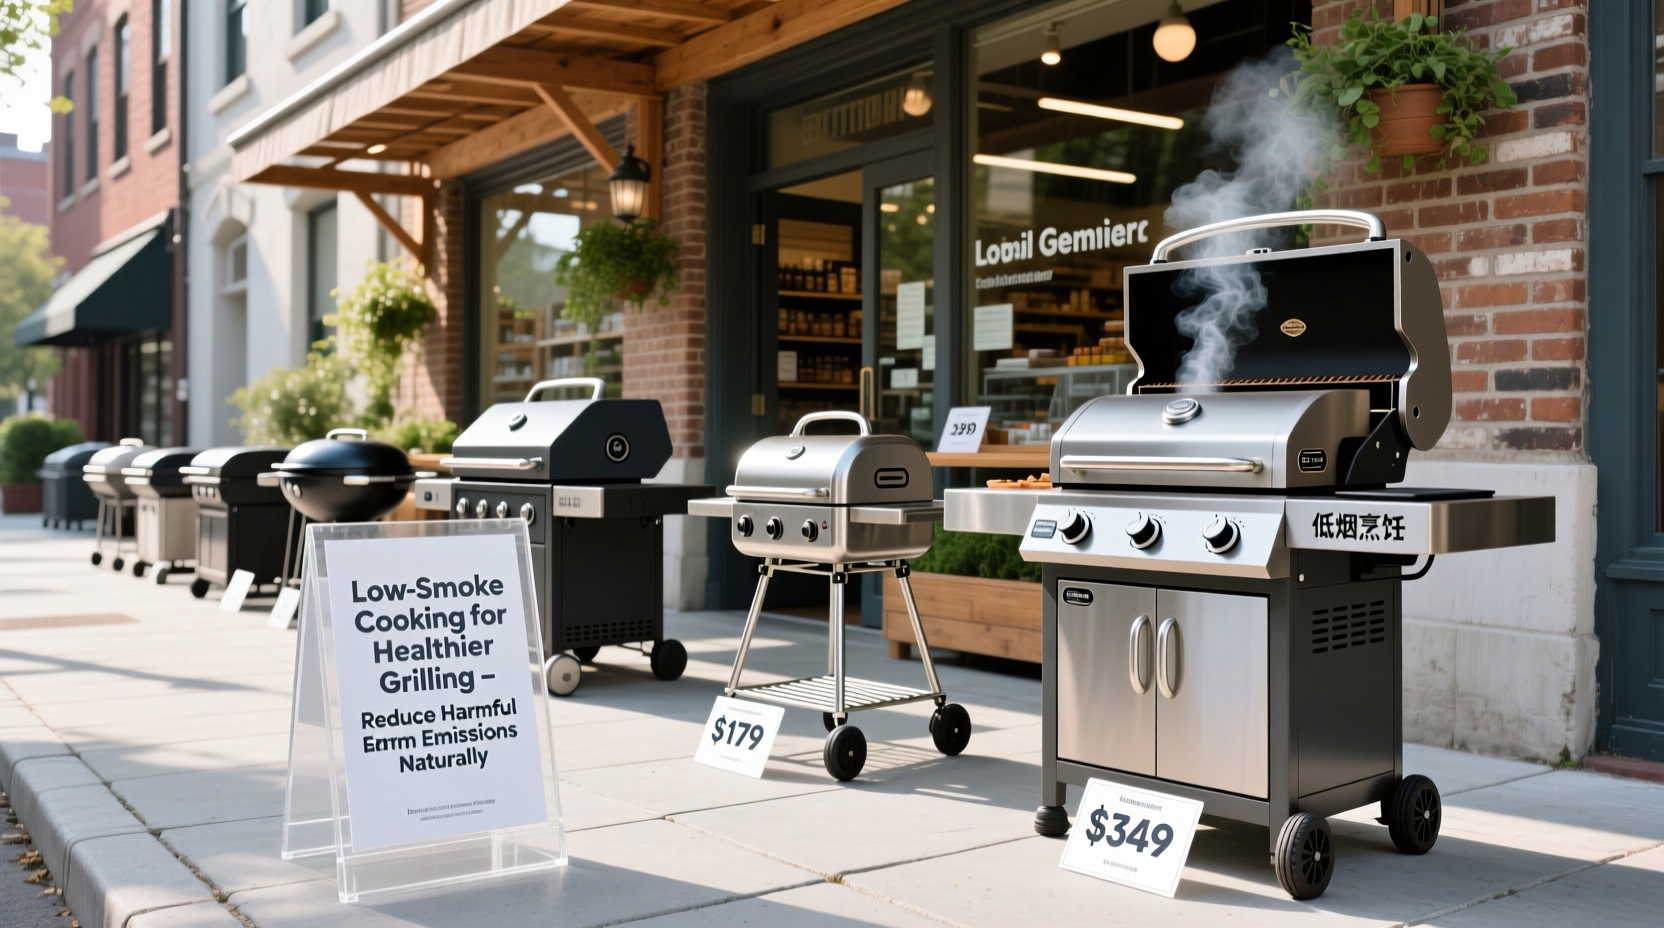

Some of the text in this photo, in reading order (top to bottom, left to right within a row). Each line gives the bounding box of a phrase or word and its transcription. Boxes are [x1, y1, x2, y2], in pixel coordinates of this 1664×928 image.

[1312, 512, 1406, 541] 低烟烹饪
[351, 574, 504, 603] Low-Smoke
[354, 603, 507, 634] Cooking for
[373, 634, 494, 664] Healthier
[379, 666, 475, 694] Grilling
[361, 697, 518, 730] Reduce Harmful
[421, 722, 518, 748] Emissions
[711, 714, 764, 751] $179
[399, 746, 489, 773] Naturally
[1085, 804, 1174, 858] $349
